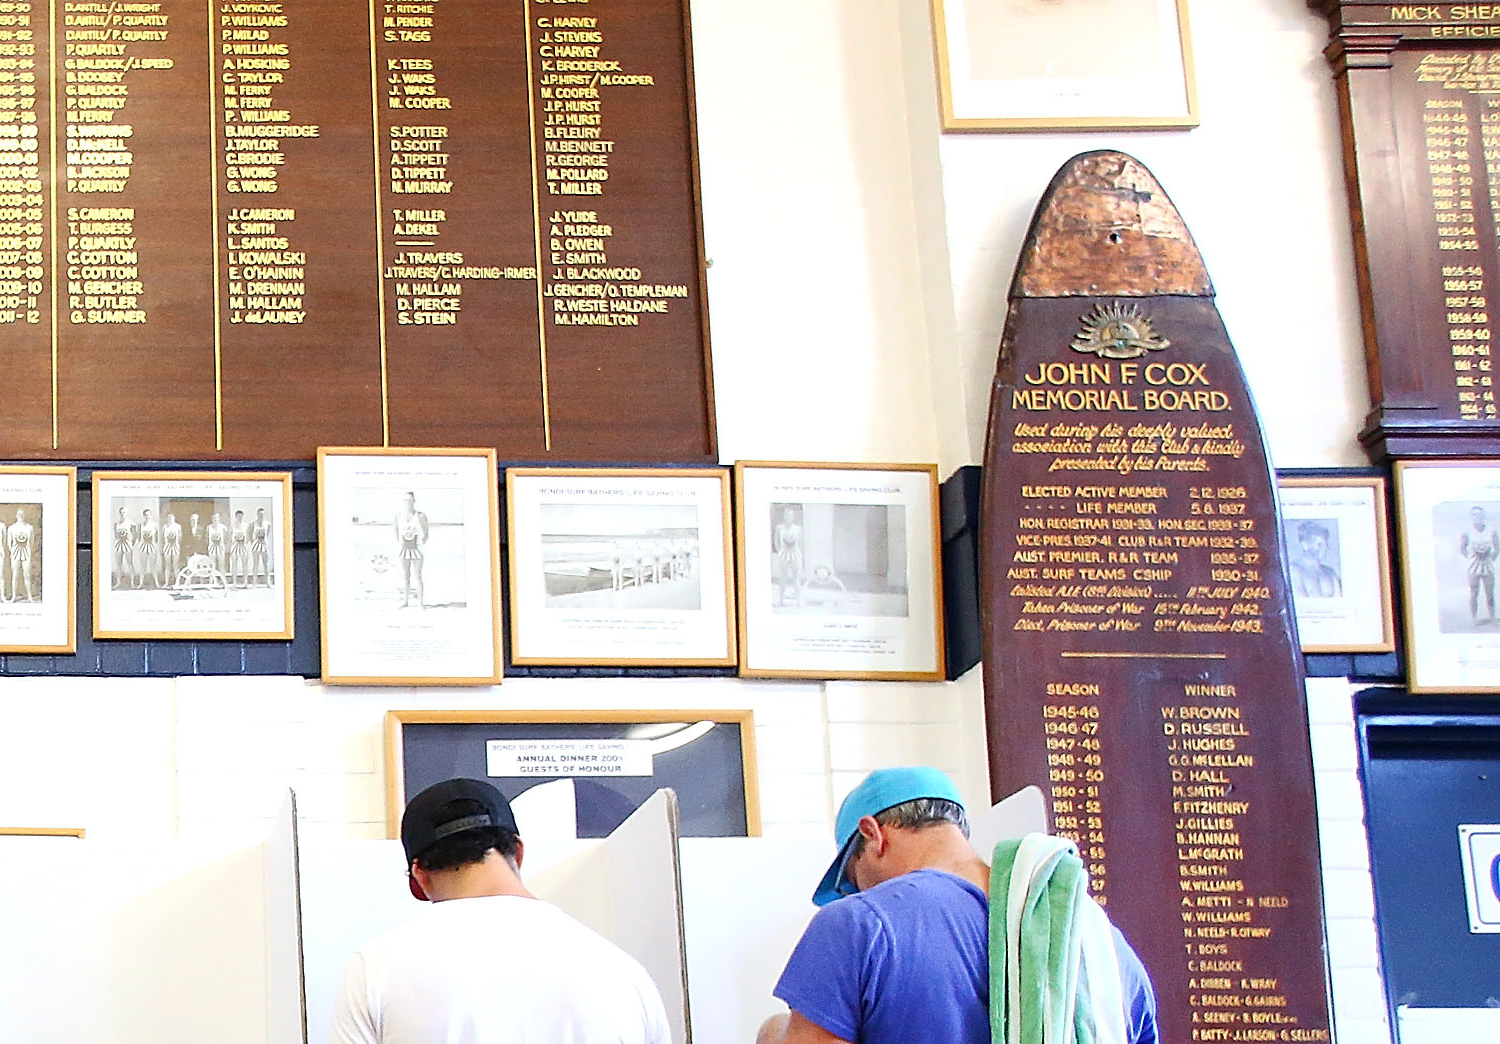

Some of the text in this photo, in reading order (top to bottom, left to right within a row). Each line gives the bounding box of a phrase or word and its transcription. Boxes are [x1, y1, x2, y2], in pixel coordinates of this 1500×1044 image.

[1391, 6, 1442, 20] MICK
[1024, 363, 1112, 385] JOHN
[1144, 363, 1210, 385] COX
[1012, 390, 1232, 411] MEMORIAL BOARD.
[1014, 422, 1177, 441] Used during his deeply
[1012, 439, 1245, 458] association with this Club kindly
[1048, 456, 1116, 472] presented
[1118, 456, 1134, 475] by
[1136, 455, 1154, 471] his
[1022, 486, 1167, 498] ELECTED ACTIVE MEMBER
[1077, 503, 1157, 514] LIFE MEMBER
[1143, 552, 1179, 564] TEAM
[1042, 569, 1074, 581] SURF
[1080, 569, 1126, 581] TEAMS
[1046, 683, 1236, 697] SEASON WINNER
[1181, 724, 1249, 735] RUSSELL
[1183, 739, 1235, 750] HUGHES
[1190, 771, 1230, 783] HALL
